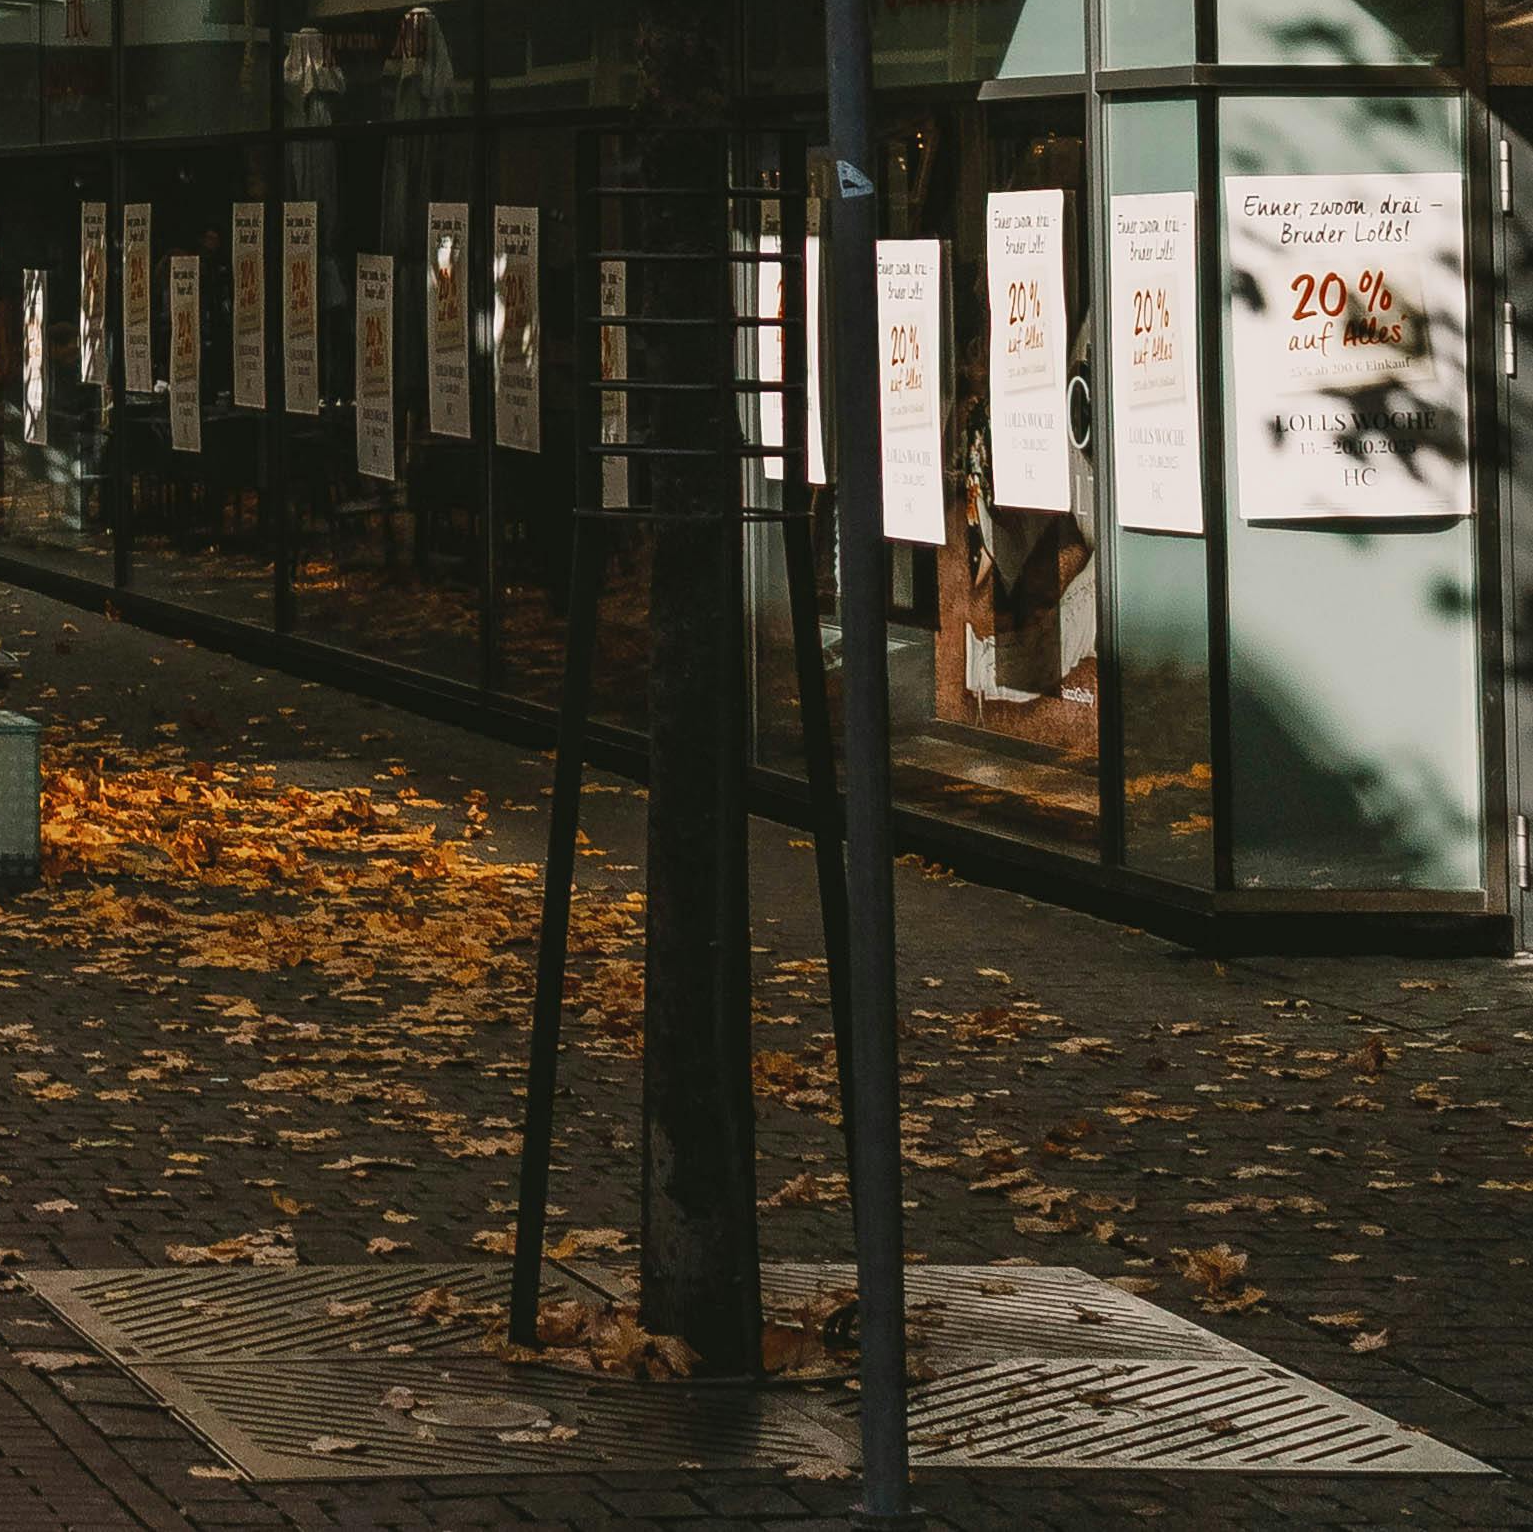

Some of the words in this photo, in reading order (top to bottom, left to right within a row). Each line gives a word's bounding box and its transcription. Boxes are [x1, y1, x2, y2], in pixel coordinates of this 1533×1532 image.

[1280, 221, 1345, 244] Bruder
[1355, 220, 1410, 244] Lolls!
[1291, 271, 1349, 322] 20
[1288, 321, 1334, 356] auf
[1366, 356, 1412, 372] Einkauf
[1273, 414, 1346, 434] LOLLS
[1352, 411, 1437, 432] WOCHE
[1343, 466, 1379, 487] HC
